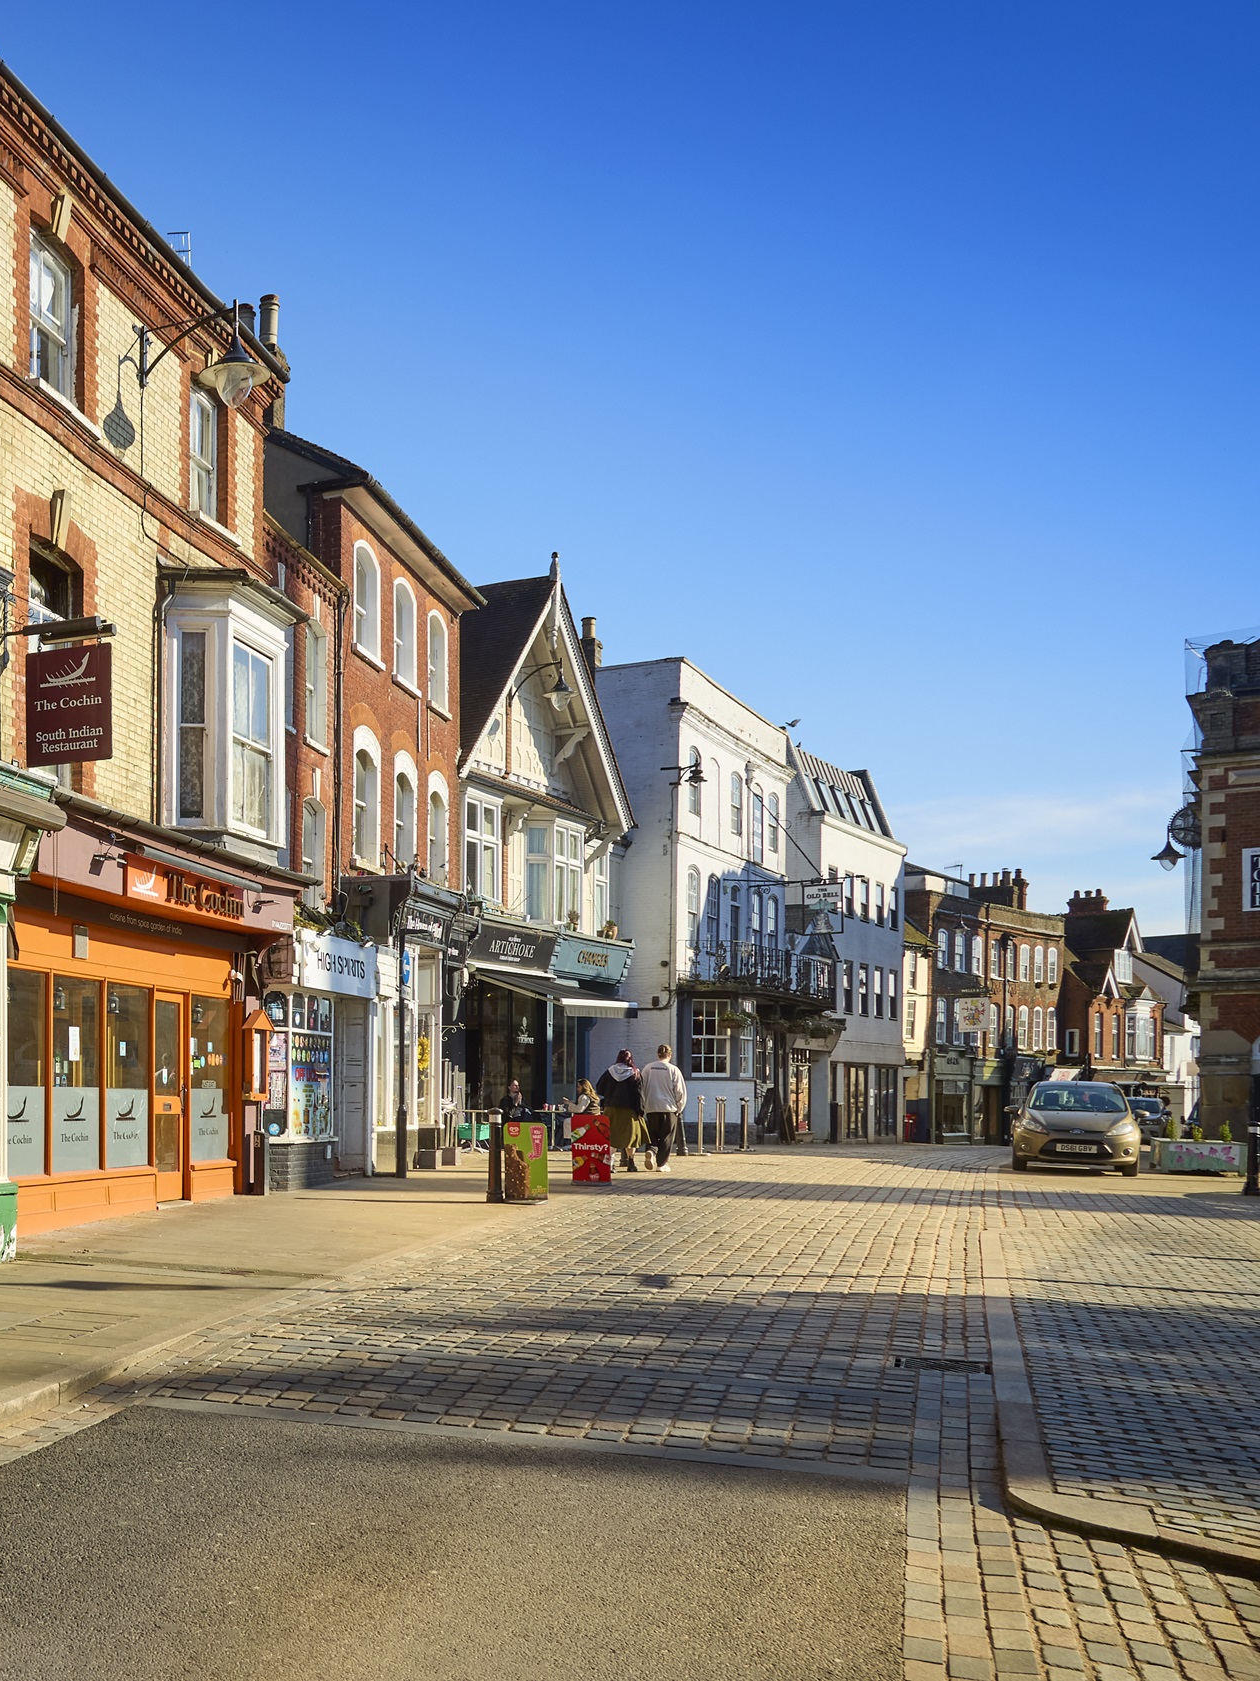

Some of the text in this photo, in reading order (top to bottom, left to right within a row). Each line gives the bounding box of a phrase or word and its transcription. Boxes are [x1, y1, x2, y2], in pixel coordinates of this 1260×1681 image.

[34, 694, 102, 712] The Cochin
[36, 725, 104, 743] South Indian
[41, 738, 98, 753] Restaurant
[167, 872, 245, 918] The Cochin
[109, 912, 126, 923] cuisine
[126, 914, 138, 925] from
[137, 919, 150, 929] spice
[149, 921, 166, 932] garden
[489, 939, 536, 959] ARTICHOKE
[317, 951, 366, 979] HIGH SPIRITS
[12, 1135, 33, 1145] Cochin
[61, 1133, 89, 1142] The Cochin
[573, 1143, 609, 1152] Thirsty?
